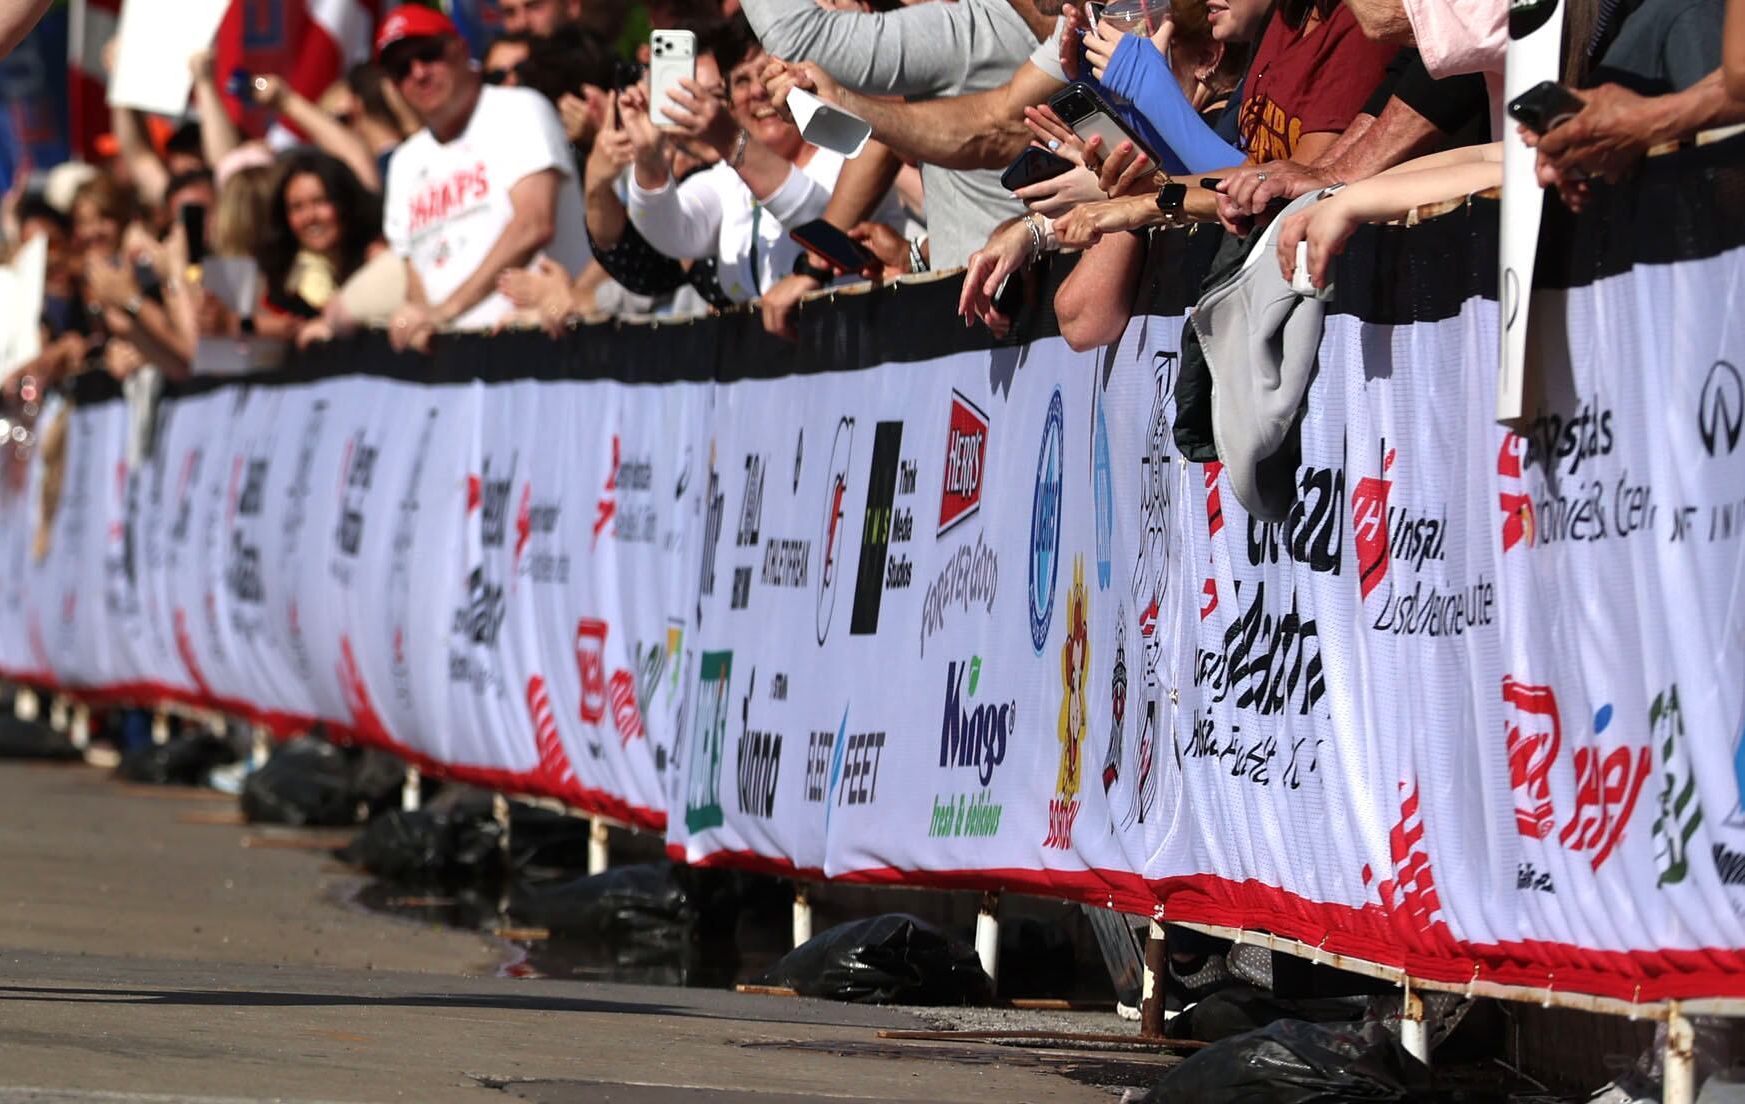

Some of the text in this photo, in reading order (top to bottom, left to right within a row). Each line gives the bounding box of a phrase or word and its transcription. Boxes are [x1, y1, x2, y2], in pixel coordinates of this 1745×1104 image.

[898, 459, 918, 496] Think
[891, 507, 914, 543] Media
[885, 553, 913, 591] Studios
[940, 656, 1010, 787] Kings
[805, 730, 835, 802] FLEET
[837, 731, 887, 809] FEET
[928, 793, 955, 838] fresh
[964, 788, 1003, 838] delicious
